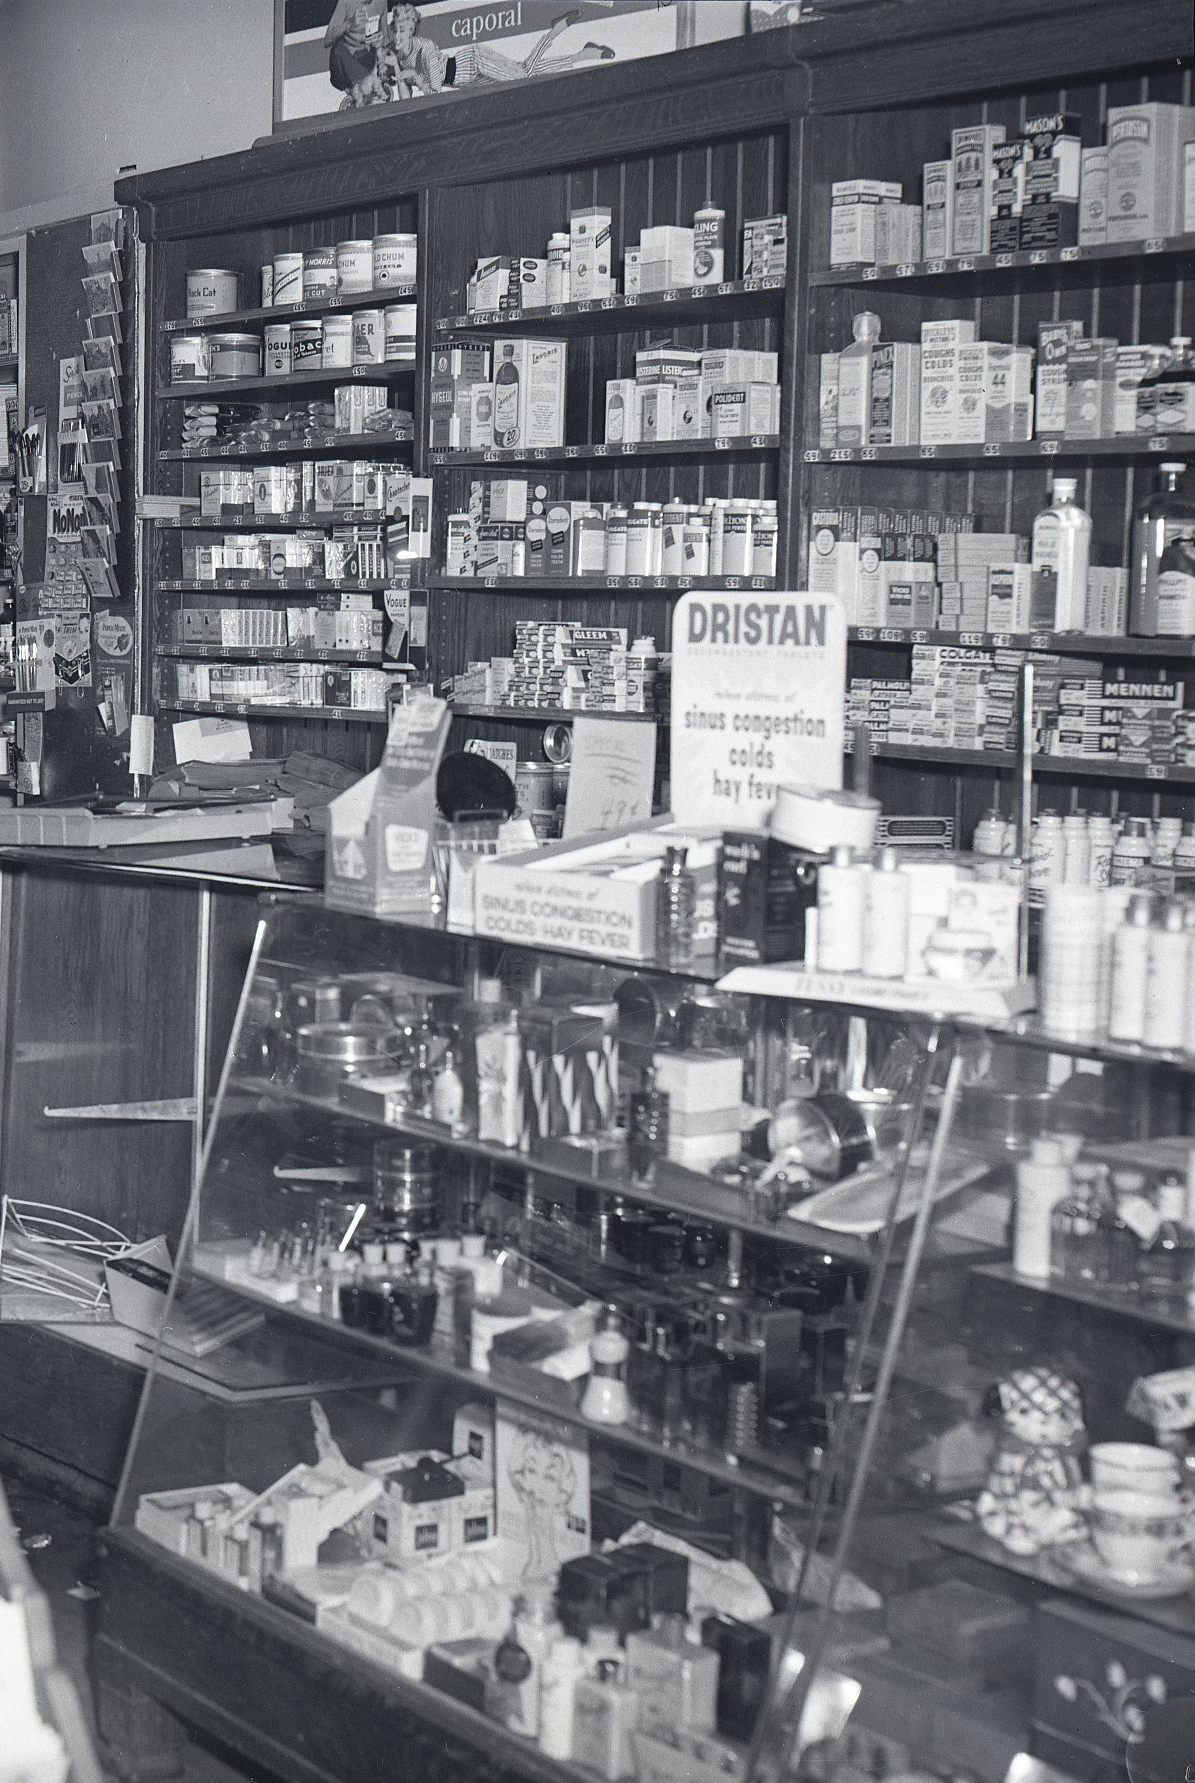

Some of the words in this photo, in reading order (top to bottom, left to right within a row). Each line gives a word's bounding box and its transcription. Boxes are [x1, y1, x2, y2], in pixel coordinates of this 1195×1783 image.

[451, 3, 523, 40] caporal
[308, 257, 334, 265] MORRIS
[202, 287, 216, 297] Cat
[923, 349, 955, 359] COUGHS
[924, 360, 954, 369] COLDS
[714, 393, 745, 404] POLIDENT
[385, 593, 407, 608] VOGUE
[688, 602, 826, 647] DRISTAN
[574, 629, 608, 640] GLEEM
[939, 649, 994, 661] COLGATE
[1105, 683, 1175, 698] MENNEN
[685, 704, 726, 731] sinus
[732, 709, 826, 741] congestion
[729, 742, 774, 770] colds
[713, 769, 742, 804] hay
[483, 894, 528, 915] SINUS
[531, 902, 633, 928] CONGESTION
[485, 915, 535, 936] COLDS
[543, 923, 574, 939] HAY
[579, 928, 631, 949] FEVER
